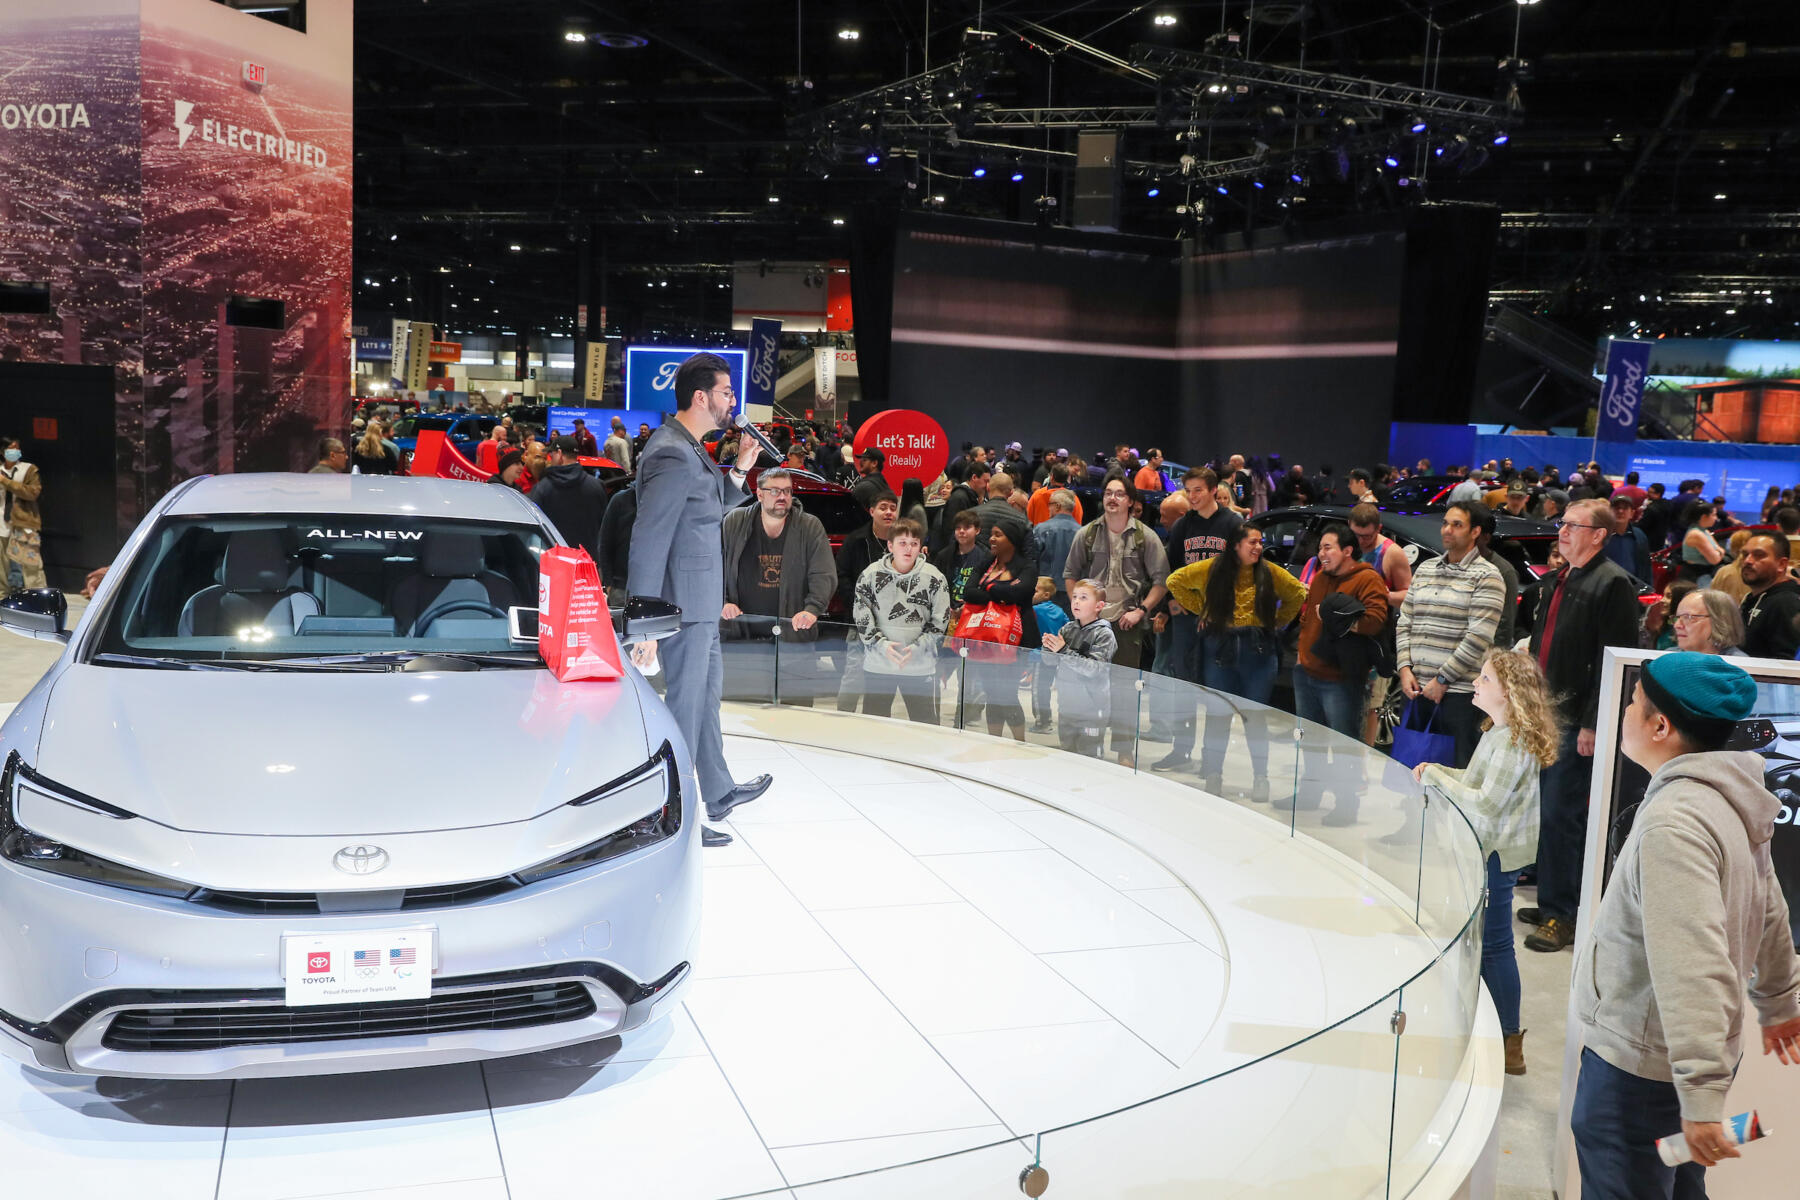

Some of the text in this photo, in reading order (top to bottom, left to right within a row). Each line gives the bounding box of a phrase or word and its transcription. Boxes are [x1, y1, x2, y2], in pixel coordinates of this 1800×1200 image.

[249, 64, 265, 83] EXIT
[0, 103, 91, 130] OYOTA
[202, 118, 328, 169] ELECTRIFIED
[751, 334, 777, 391] Ford
[835, 352, 857, 362] FOO
[1606, 358, 1643, 427] Ford
[876, 433, 936, 449] Let's Talk!
[888, 454, 922, 469] (Really)
[449, 463, 471, 482] LET'S
[306, 528, 424, 541] ALL-NEW
[539, 621, 553, 638] OTA
[302, 976, 336, 985] TOYOTA
